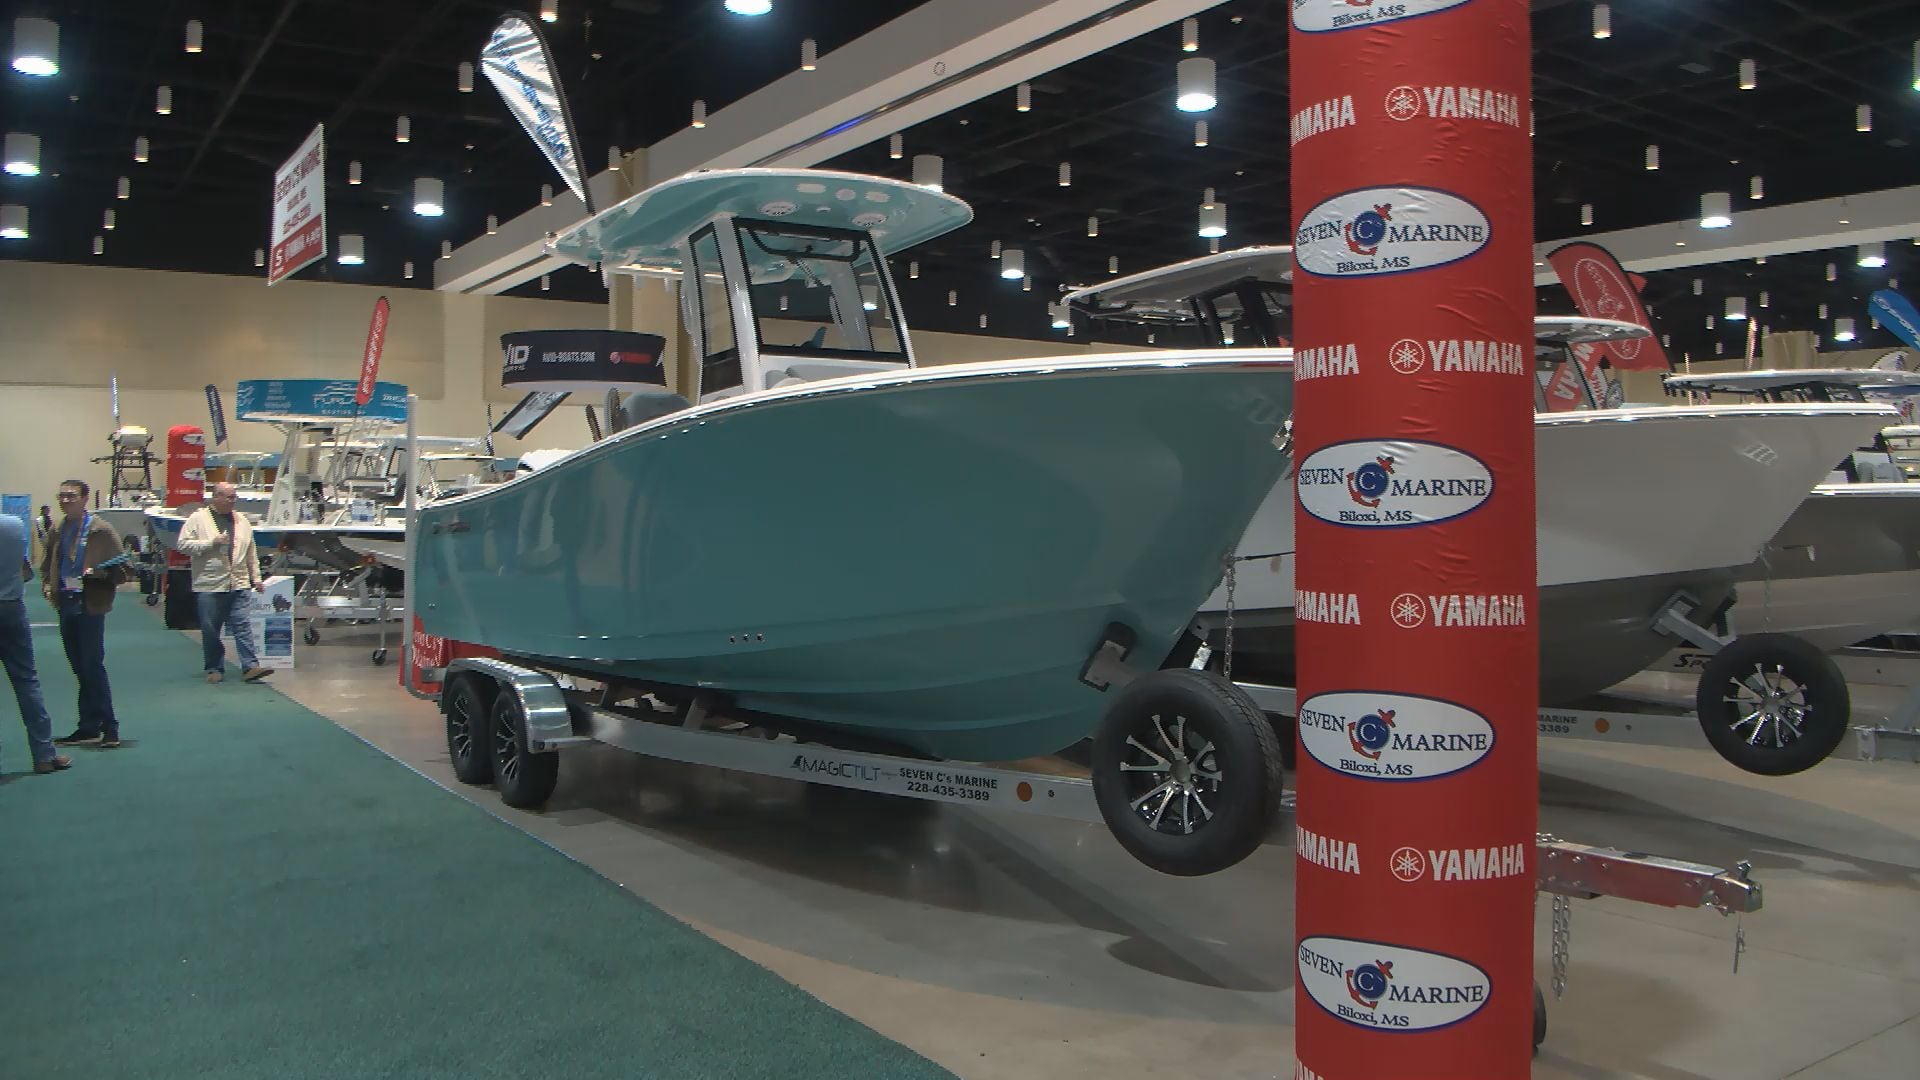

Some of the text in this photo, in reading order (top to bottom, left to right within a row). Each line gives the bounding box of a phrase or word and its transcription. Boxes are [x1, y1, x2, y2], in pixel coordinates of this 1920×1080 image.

[1332, 4, 1405, 27] Biloxi, MS
[1423, 87, 1520, 127] YAMAHA
[1298, 220, 1342, 246] SEVEN
[1388, 225, 1484, 243] MARINE
[1337, 256, 1410, 273] Biloxi, MS
[1427, 340, 1523, 376] YAMAHA
[1300, 468, 1344, 485] SEVEN
[1391, 479, 1486, 497] MARINE
[1339, 510, 1412, 523] Biloxi, MS
[1429, 594, 1526, 627] YAMAHA
[1301, 708, 1346, 732] SEVEN
[1391, 733, 1487, 751] MARINE
[900, 767, 933, 781] SEVEN
[955, 774, 998, 790] MARINE
[1340, 758, 1413, 776] Biloxi, MS
[907, 781, 990, 801] 228-435-3389
[1429, 843, 1525, 881] YAMAHA
[1300, 945, 1344, 978] SEVEN
[1389, 985, 1484, 1004] MARINE
[1337, 1004, 1409, 1026] Biloxi, MS
